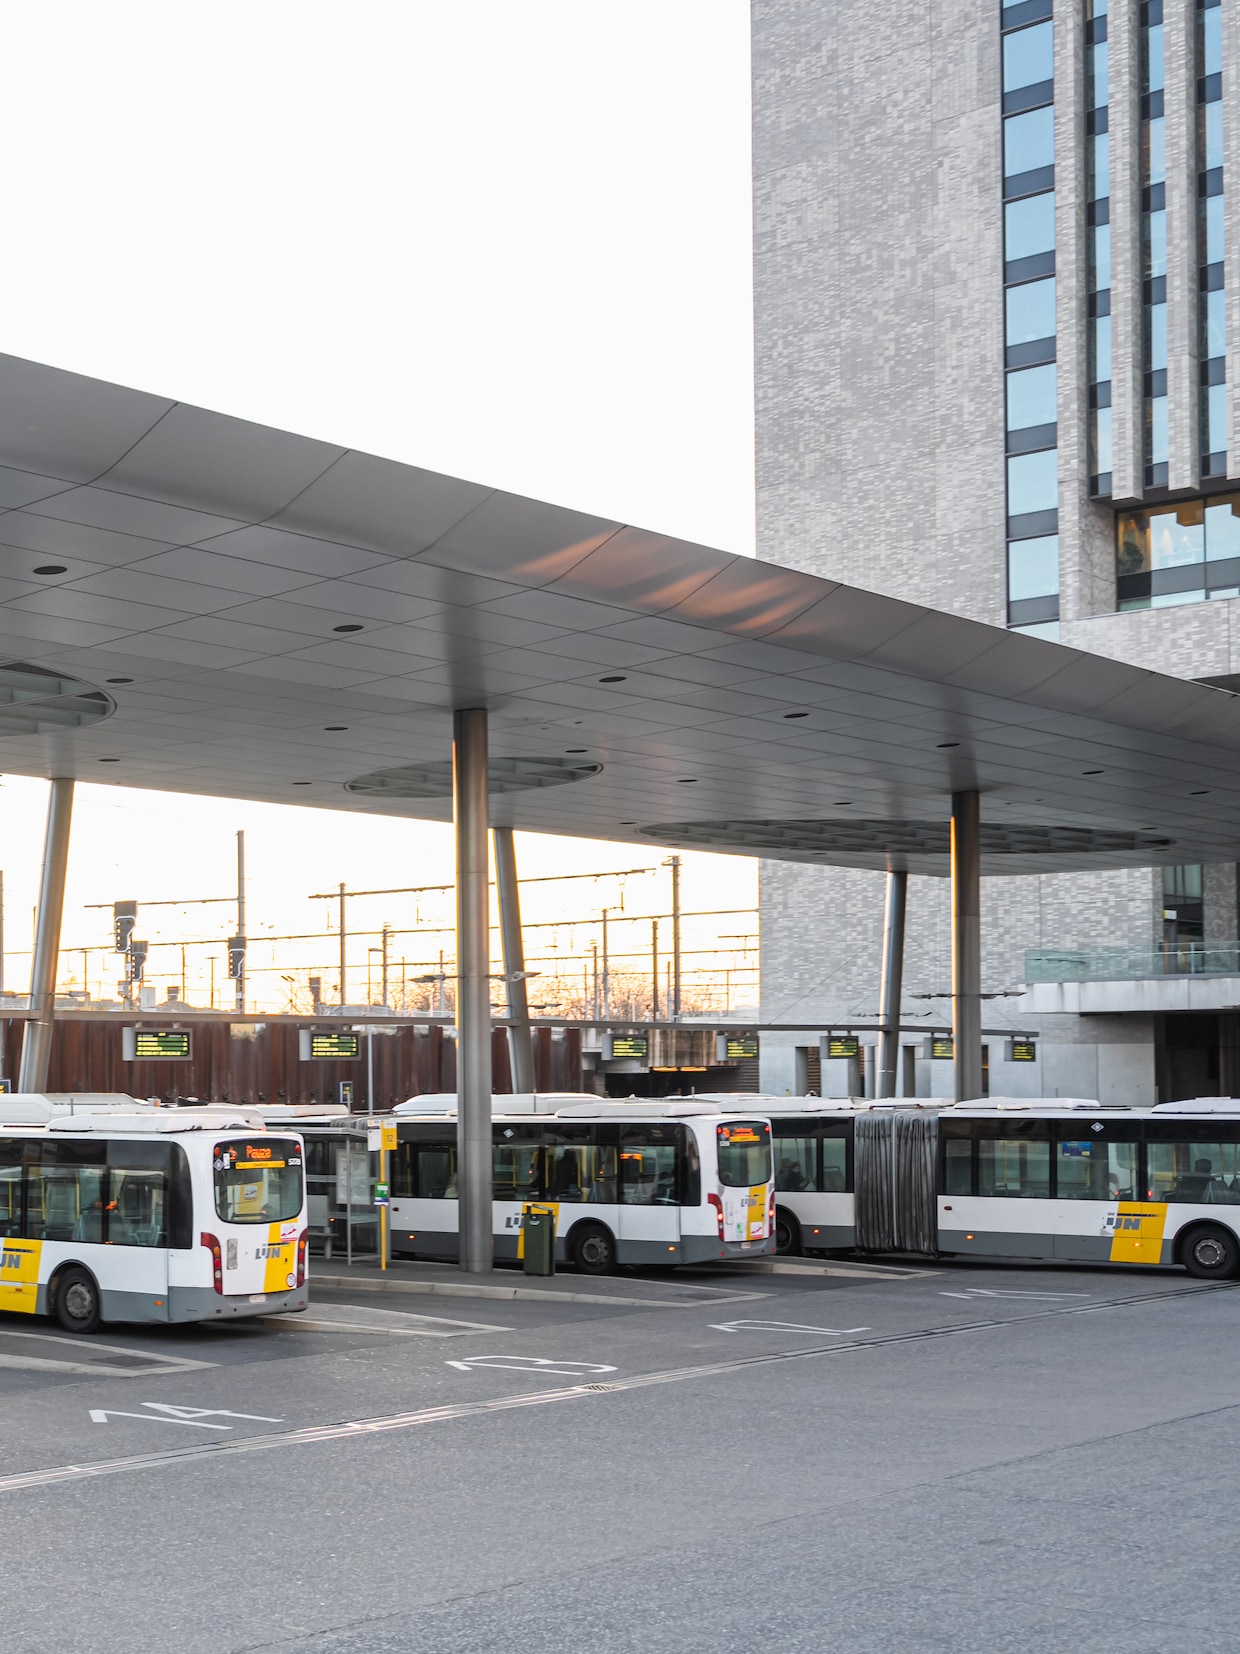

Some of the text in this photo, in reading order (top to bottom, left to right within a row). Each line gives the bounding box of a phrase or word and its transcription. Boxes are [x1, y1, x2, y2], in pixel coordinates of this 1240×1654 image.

[255, 1247, 281, 1260] LIJN
[706, 1319, 872, 1336] 12
[444, 1355, 619, 1377] 13
[88, 1401, 285, 1430] 14
